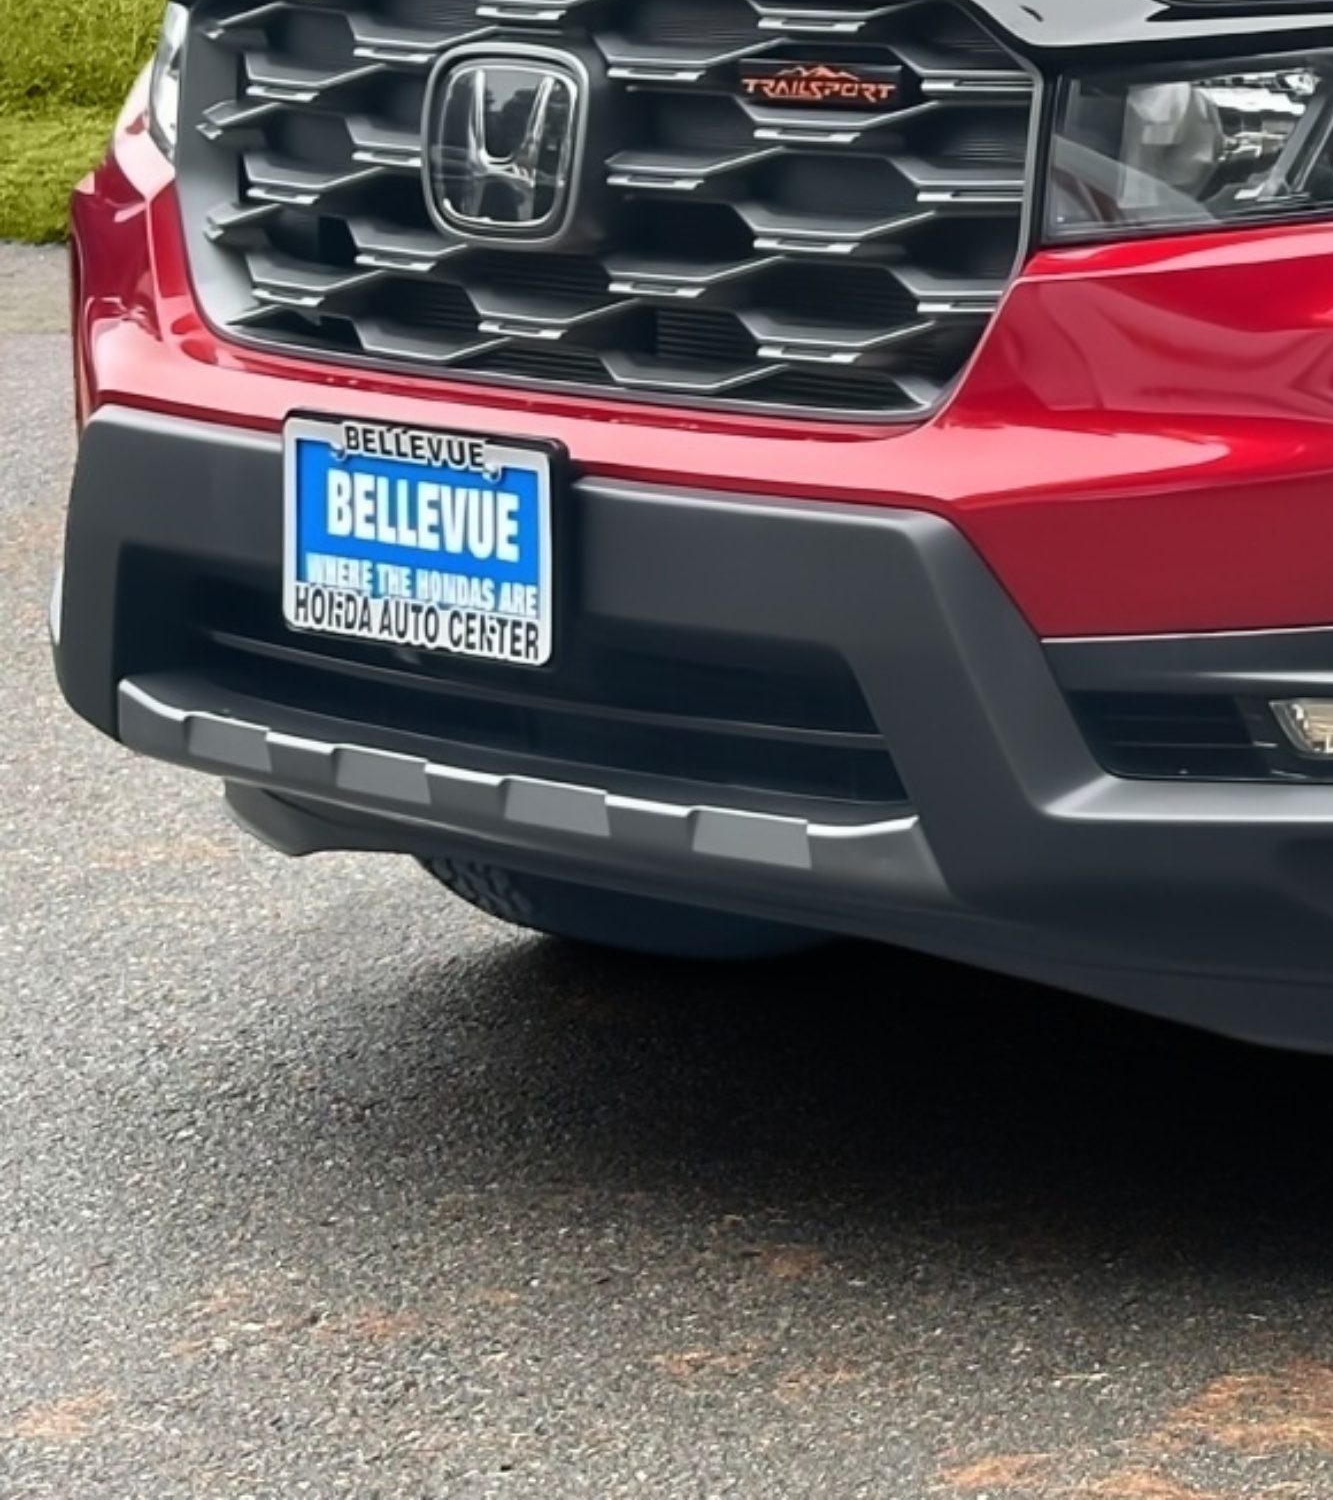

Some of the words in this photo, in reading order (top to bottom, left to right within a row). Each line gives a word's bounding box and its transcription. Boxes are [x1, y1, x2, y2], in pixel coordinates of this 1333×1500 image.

[741, 78, 896, 103] TRAILSPORT
[344, 425, 485, 468] BELLEVUE
[326, 468, 520, 563] BELLEVUE
[305, 552, 373, 592] WHERE
[376, 563, 412, 599] THE
[416, 569, 495, 611] HONDAS
[498, 582, 538, 617] ARE
[294, 584, 373, 634] HONDA
[379, 599, 440, 643] AUTO
[448, 609, 539, 660] CENTER
